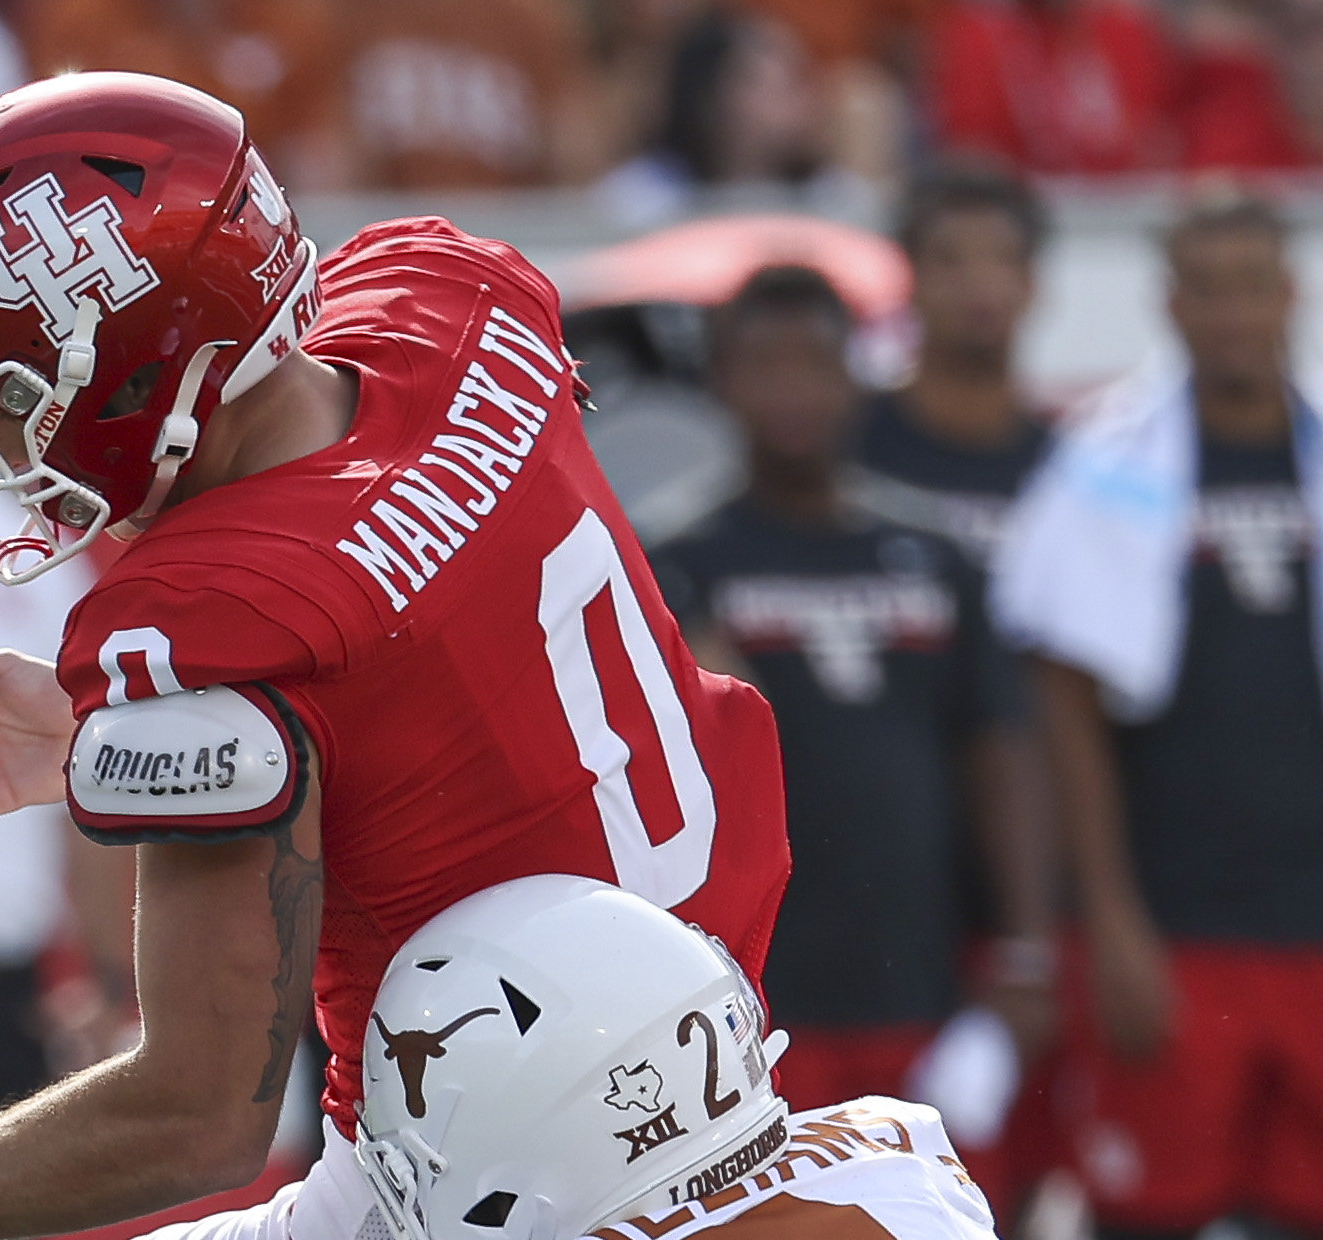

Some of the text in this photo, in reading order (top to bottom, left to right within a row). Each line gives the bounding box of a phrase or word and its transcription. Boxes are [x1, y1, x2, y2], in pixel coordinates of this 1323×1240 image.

[335, 305, 565, 613] MANJACK IV
[538, 507, 716, 912] 0
[676, 1010, 742, 1121] 2
[613, 1101, 689, 1165] XII
[668, 1115, 788, 1206] LONGHORNS
